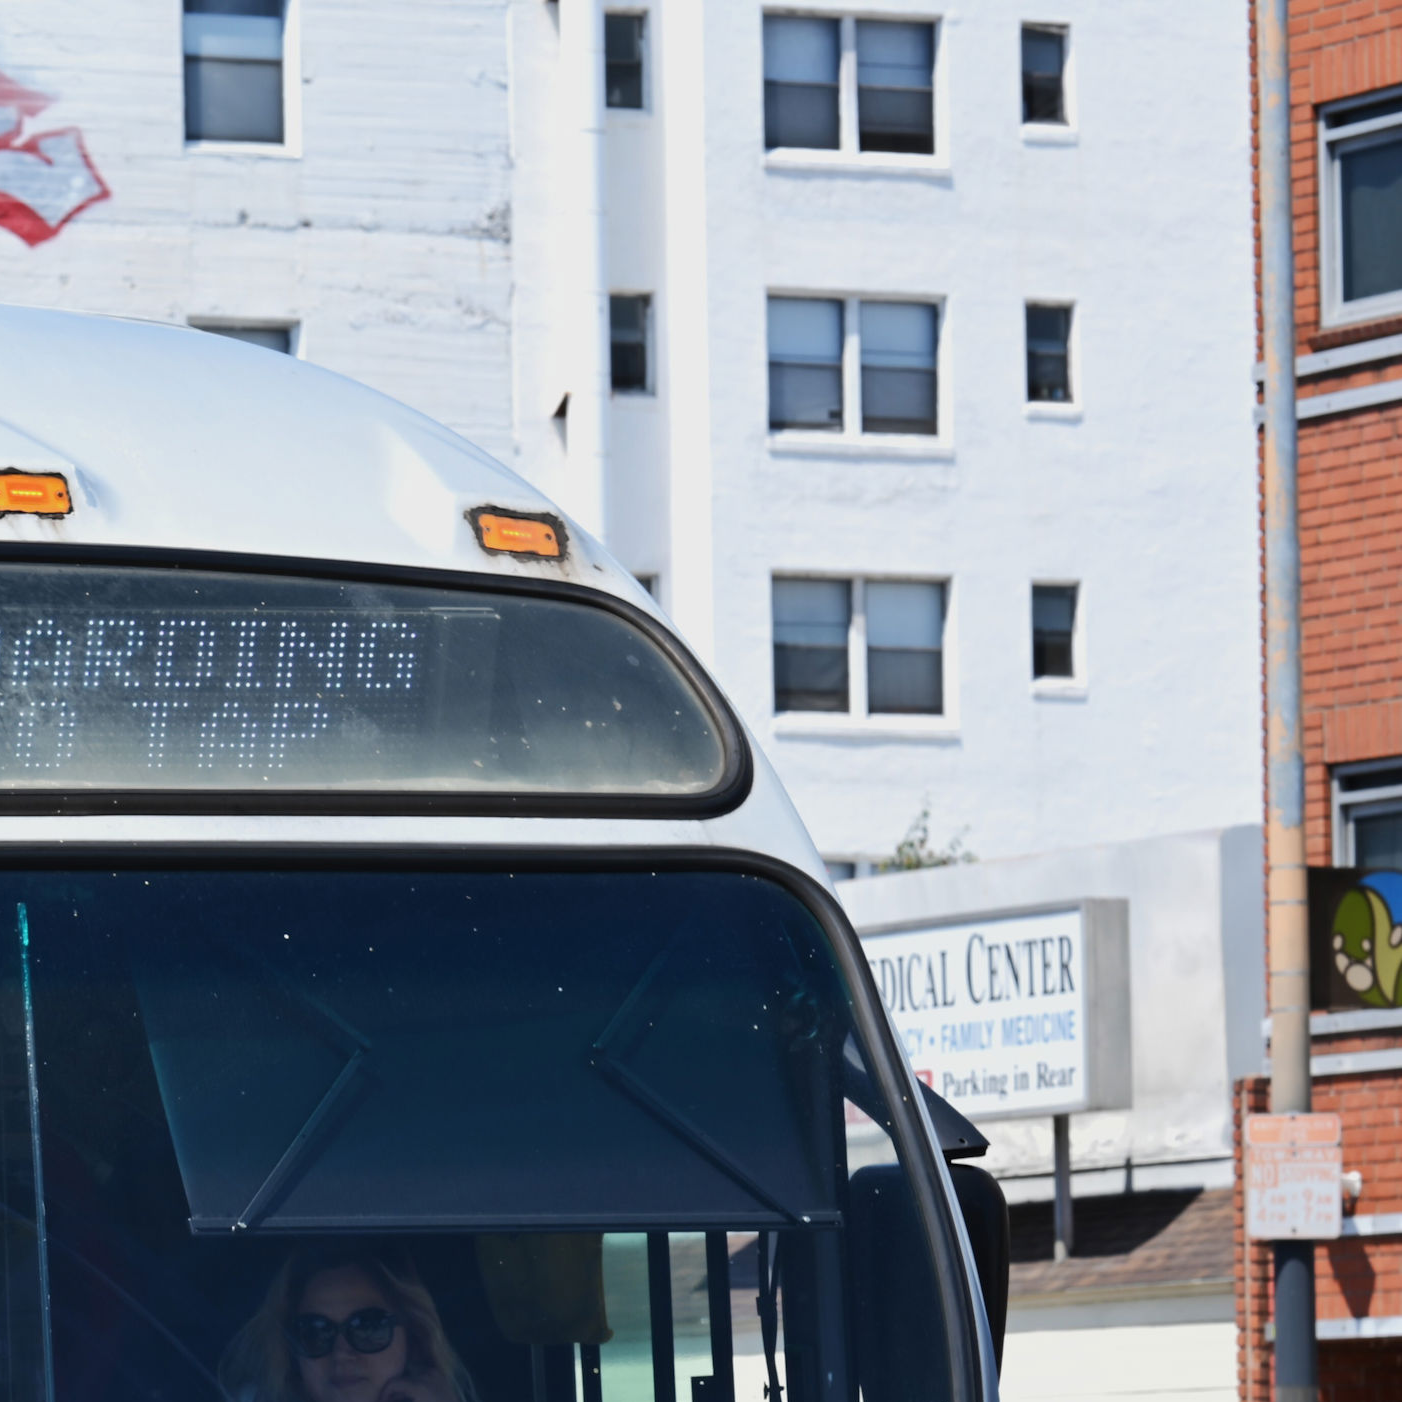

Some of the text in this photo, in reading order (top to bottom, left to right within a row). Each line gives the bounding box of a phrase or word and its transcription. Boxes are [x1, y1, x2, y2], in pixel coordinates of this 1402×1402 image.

[132, 702, 328, 768] TAP
[966, 933, 1076, 1005] CENTER
[941, 1019, 995, 1053] FAMILY
[1001, 1010, 1076, 1047] MEDICINE
[943, 1062, 1076, 1099] Parking in Rear
